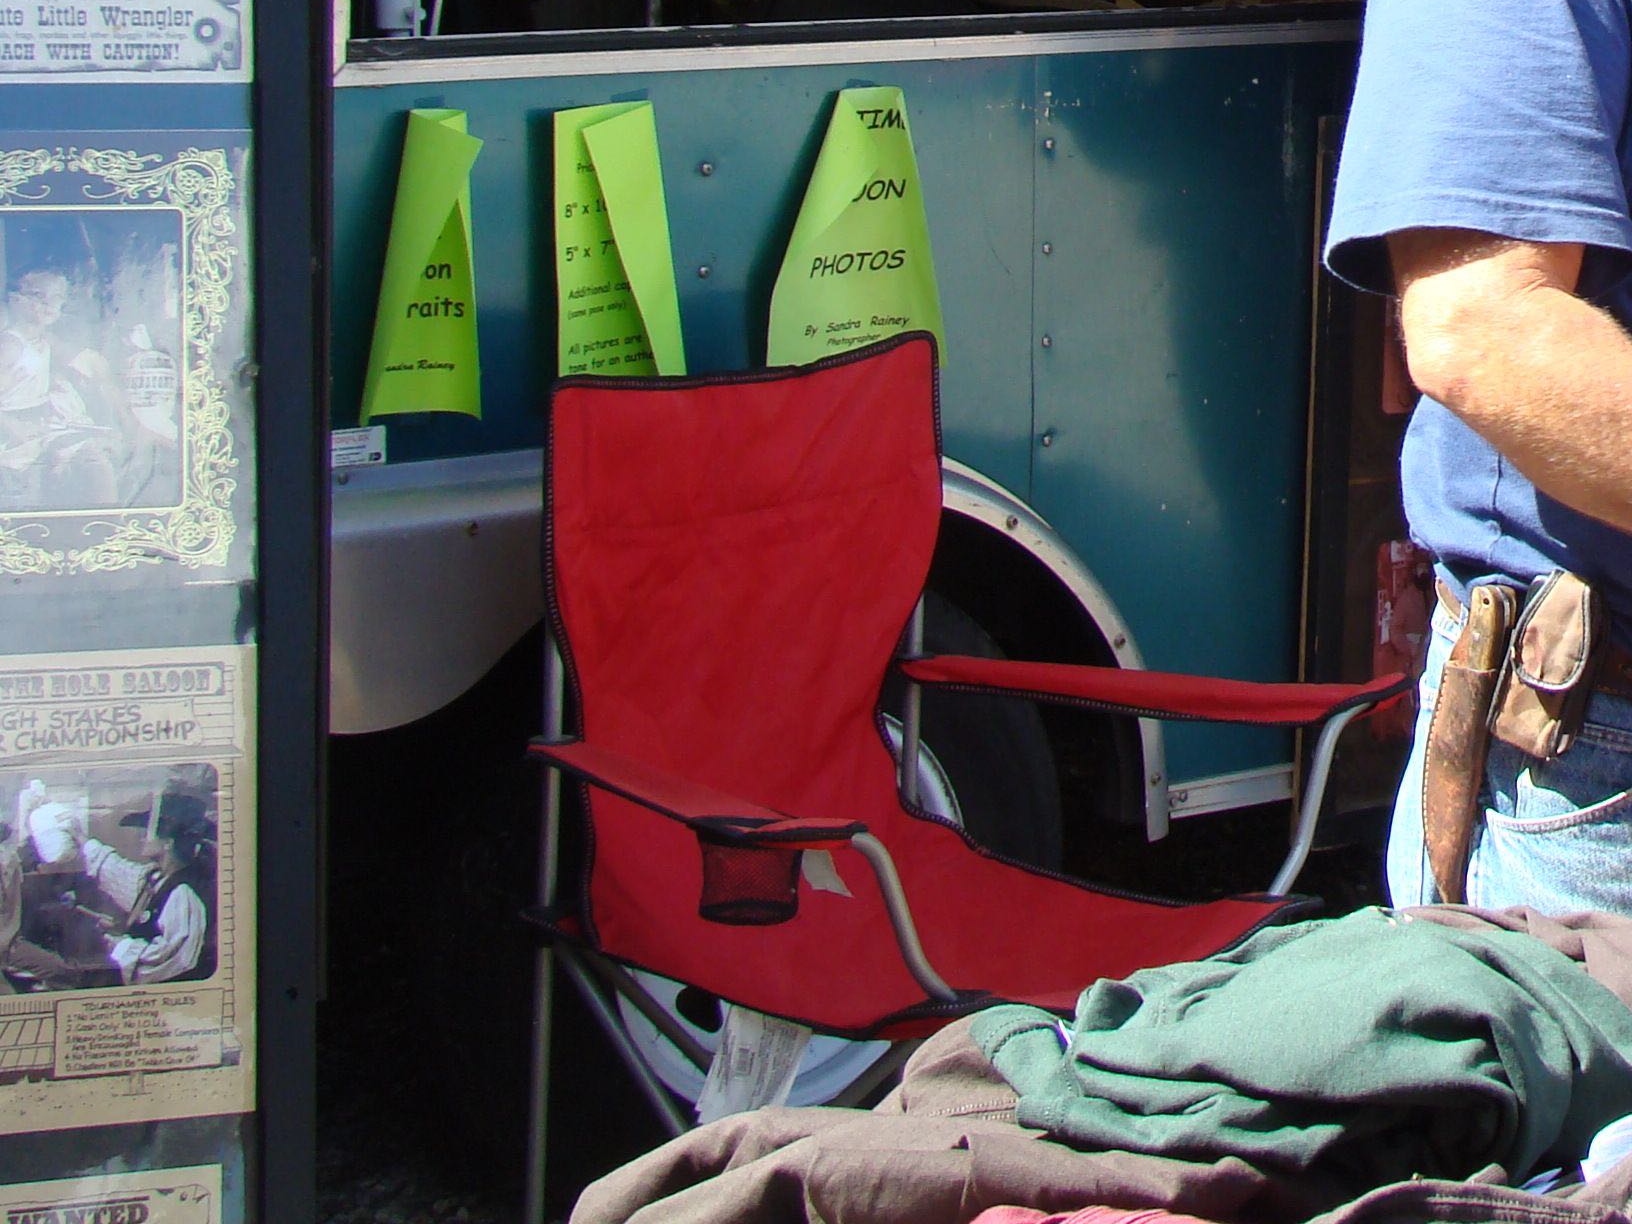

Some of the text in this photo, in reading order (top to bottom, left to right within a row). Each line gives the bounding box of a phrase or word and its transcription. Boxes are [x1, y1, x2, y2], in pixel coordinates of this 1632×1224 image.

[37, 6, 87, 26] Little
[100, 6, 194, 30] Wrangler
[1, 43, 180, 60] ACH WITH CAUTION!
[582, 204, 590, 215] x
[583, 247, 591, 257] x
[424, 263, 452, 279] on
[810, 249, 906, 278] PHOTOS
[568, 281, 611, 299] Additional
[407, 296, 465, 318] raits
[804, 315, 911, 337] By Sandra Rainey
[568, 343, 580, 355] All
[583, 338, 620, 355] pictures
[826, 333, 881, 346] Photographer
[609, 356, 620, 366] an
[50, 673, 111, 696] HOLE
[122, 669, 211, 694] SALOON
[1, 704, 142, 731] GH STAKES
[15, 720, 196, 751] CHAMPIONSHIP
[82, 996, 196, 1011] TOURNAMENT RULES
